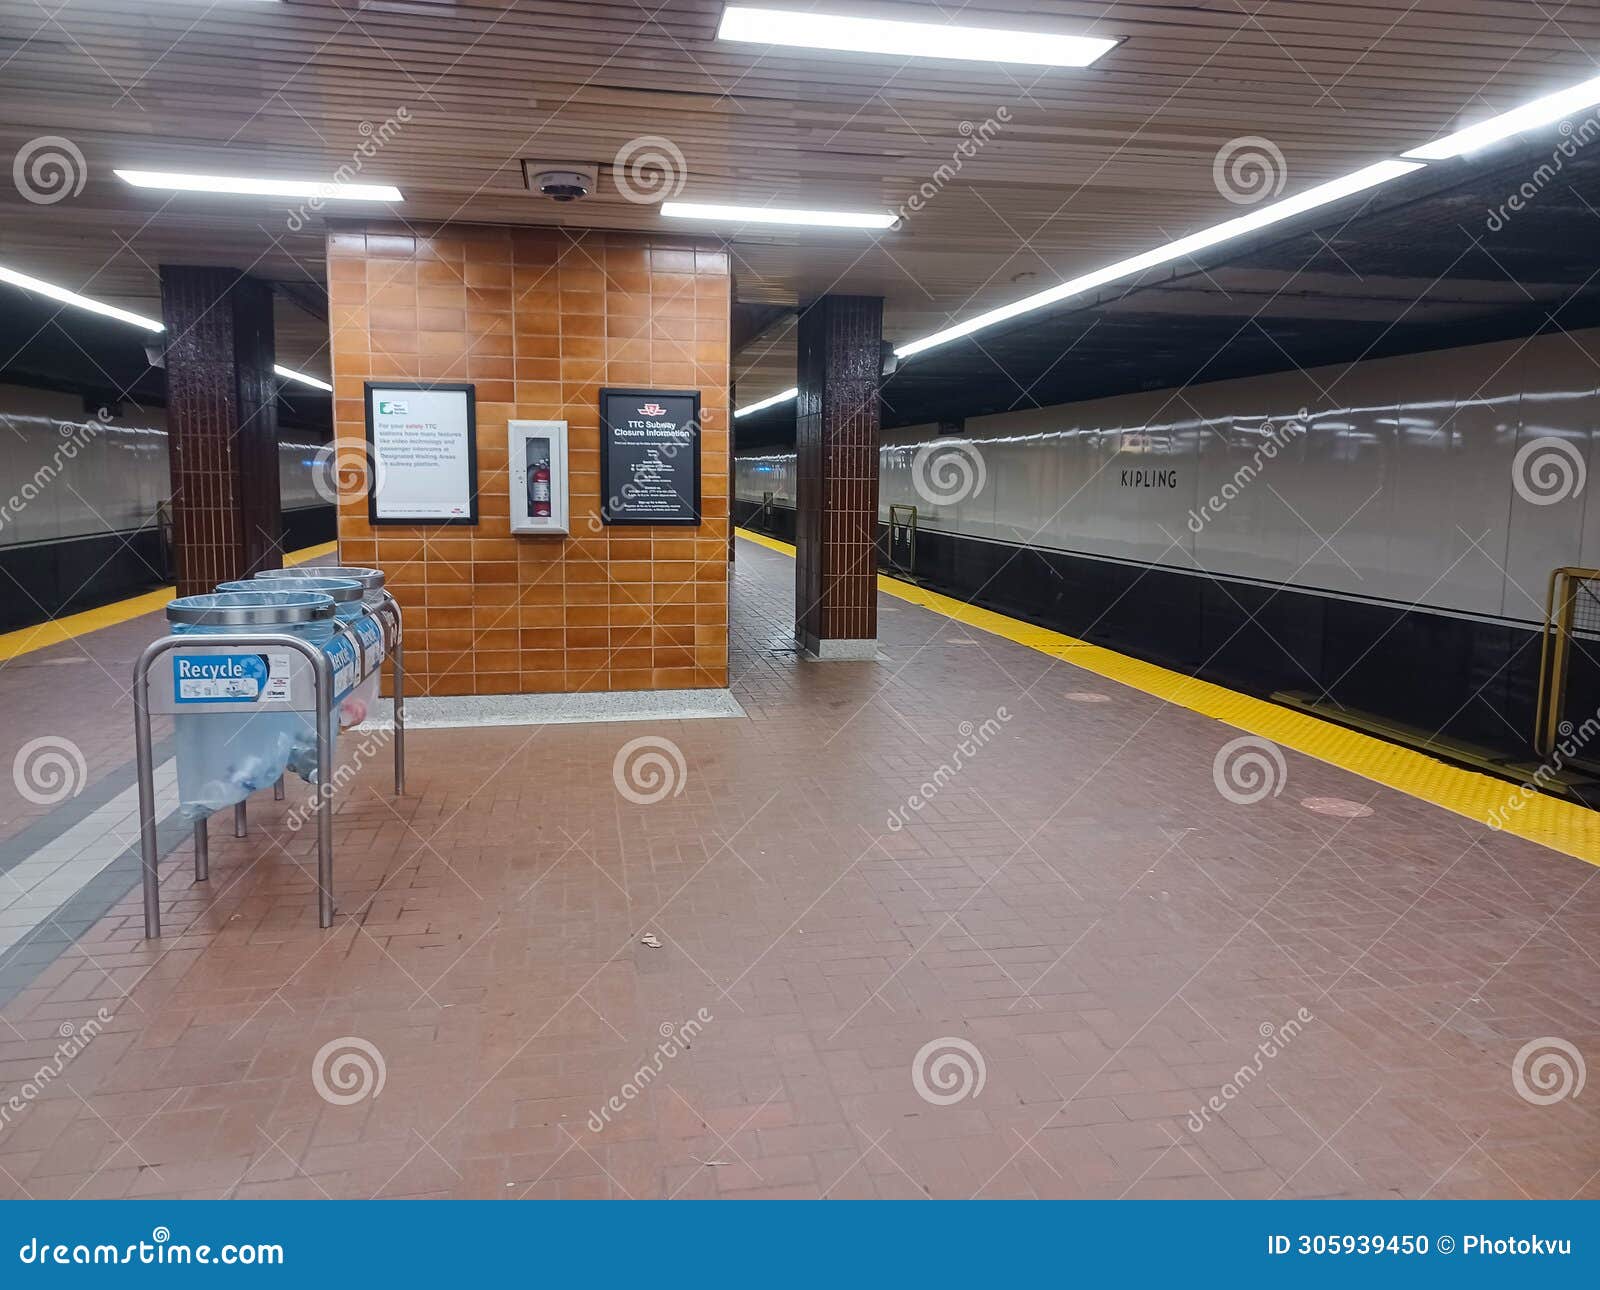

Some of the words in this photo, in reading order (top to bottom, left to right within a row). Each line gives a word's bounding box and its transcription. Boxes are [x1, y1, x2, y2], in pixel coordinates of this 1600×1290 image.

[628, 420, 645, 428] TTC
[645, 420, 676, 430] Subway
[614, 428, 645, 436] Closure
[646, 429, 690, 437] Information
[1121, 470, 1177, 488] KIPLING
[179, 657, 243, 682] Recycle
